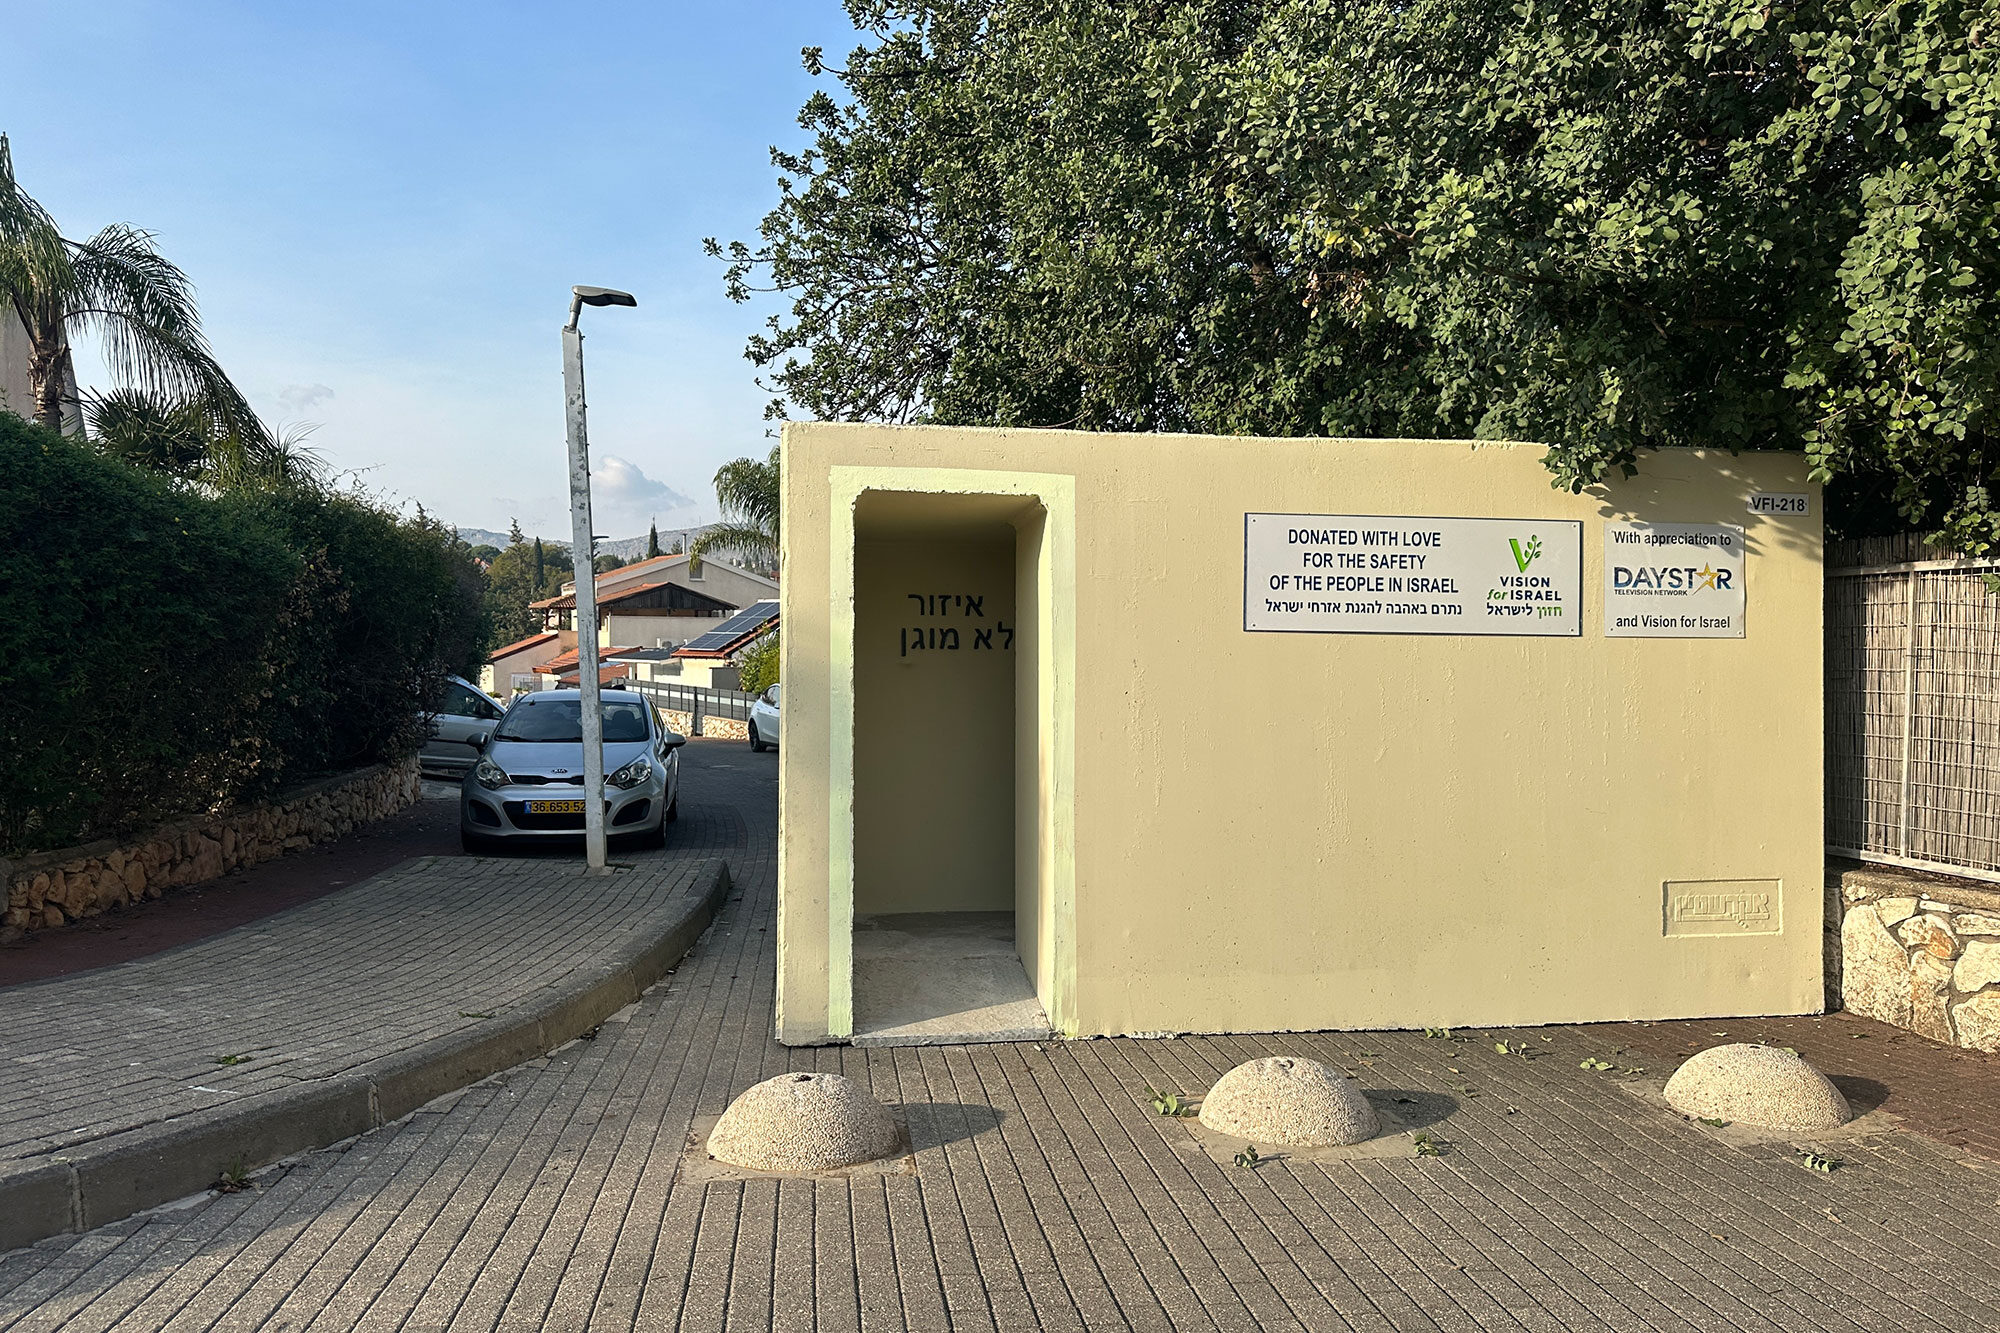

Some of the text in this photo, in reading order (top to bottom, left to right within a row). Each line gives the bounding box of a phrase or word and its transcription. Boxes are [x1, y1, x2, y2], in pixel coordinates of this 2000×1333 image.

[1752, 497, 1805, 512] VFI-218
[1288, 529, 1441, 547] DONATED WITH LOVE
[1614, 531, 1731, 547] With appreciation to
[1303, 552, 1426, 569] FOR THE SAFETY
[1269, 575, 1459, 593] OF THE PEOPLE IN ISRAEL
[1500, 576, 1550, 587] VISION
[1487, 588, 1562, 601] for ISRAEL
[908, 593, 984, 617] איזור
[1265, 598, 1462, 616] נתרם באהבה להגנת אזרחי ישראל
[1486, 602, 1562, 620] חזון לישראל
[1616, 614, 1730, 629] and Vision for Israel
[901, 621, 1014, 657] לא מוגן
